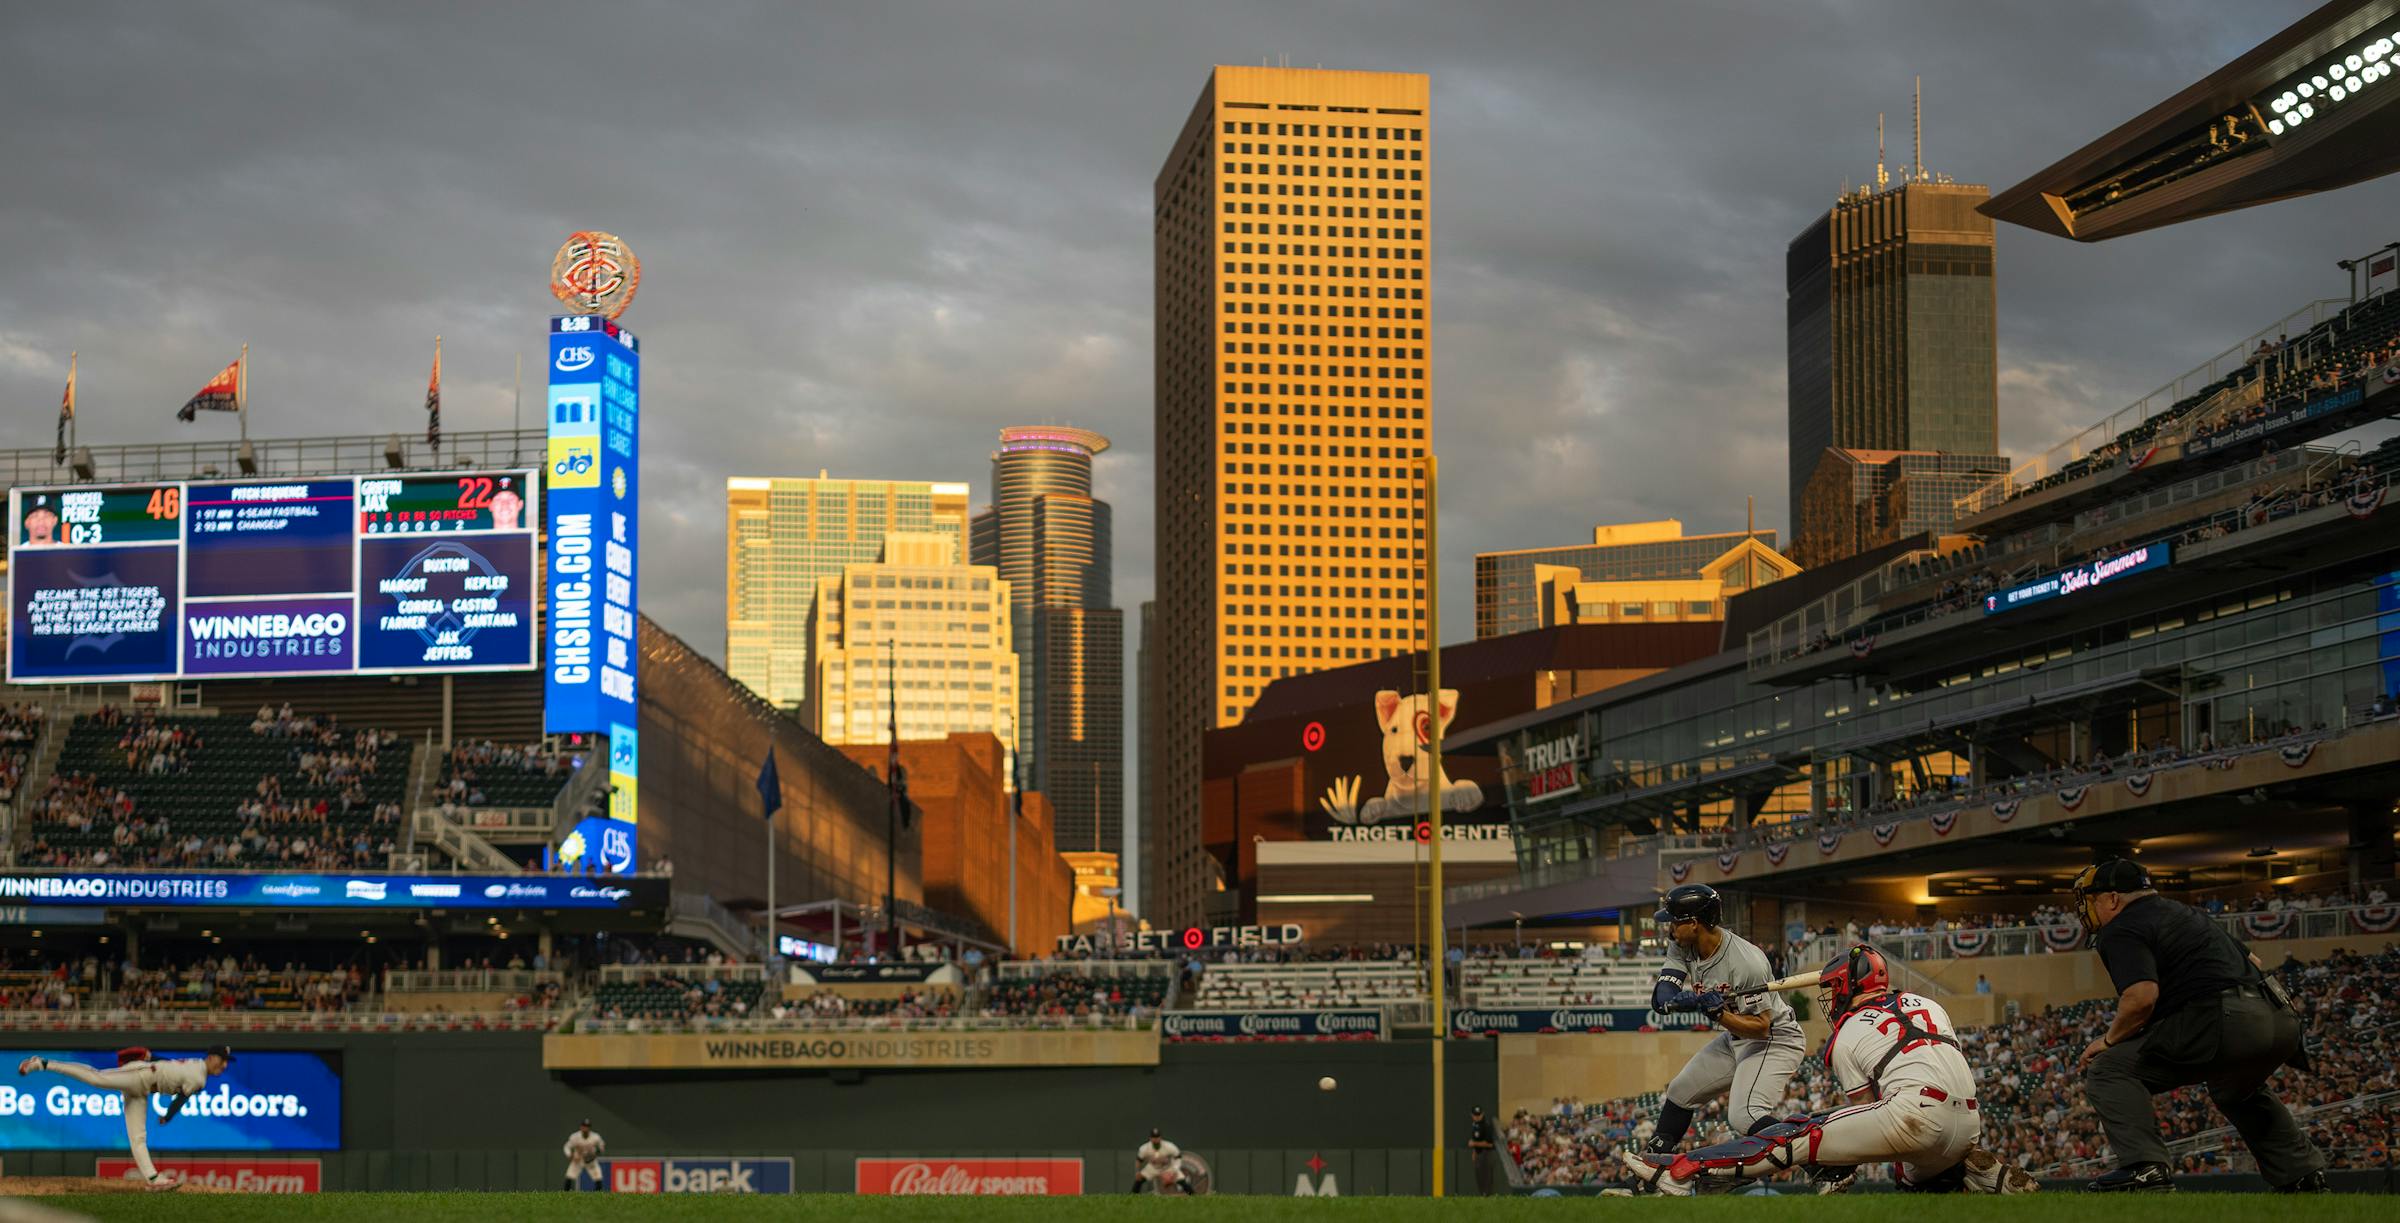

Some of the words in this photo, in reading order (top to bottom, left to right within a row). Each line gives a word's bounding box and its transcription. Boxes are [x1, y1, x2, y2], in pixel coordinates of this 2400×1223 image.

[146, 487, 180, 520] 46
[360, 494, 389, 513] JAX
[458, 477, 494, 510] 22
[70, 523, 103, 545] 0-3
[455, 519, 465, 531] 2
[422, 557, 470, 574] BUXTON
[120, 586, 159, 599] TIGERS
[379, 577, 428, 594] MARGOT
[464, 575, 509, 592] KEPLER
[27, 600, 69, 614] PLAYER
[397, 599, 445, 615] CORREA
[451, 597, 498, 613] CASTRO
[555, 513, 592, 685] CHSINC.COM
[108, 609, 146, 622] GAMES
[379, 615, 428, 631] FARMER
[463, 612, 518, 629] SANTANA
[72, 621, 115, 635] LEAGUE
[115, 620, 160, 633] CAREER
[188, 612, 347, 641] WINNEBAGO
[194, 637, 342, 659] INDUSTRIES
[435, 630, 461, 646] JAX
[1524, 733, 1580, 773] TRULY
[1328, 825, 1413, 841] TARGET
[1440, 824, 1524, 840] CENTE
[0, 877, 107, 897] INNEBAGO
[106, 879, 229, 898] INDUSTRIES
[1212, 923, 1304, 947] FIELD
[1658, 975, 1682, 988] PERE
[1165, 1014, 1225, 1035] Corona
[1240, 1013, 1300, 1035] Corona
[1315, 1012, 1377, 1034] Corona
[1455, 1009, 1519, 1031] Corona
[1551, 1009, 1614, 1031] Corona
[706, 1039, 846, 1060] WINNEBAGO
[847, 1039, 993, 1060] INDUSTRIES
[0, 1085, 35, 1116] Be
[46, 1085, 126, 1116] Grea
[615, 1167, 658, 1193] us
[664, 1160, 756, 1194] bank
[890, 1163, 979, 1195] Bally
[980, 1176, 1049, 1195] SPORTS
